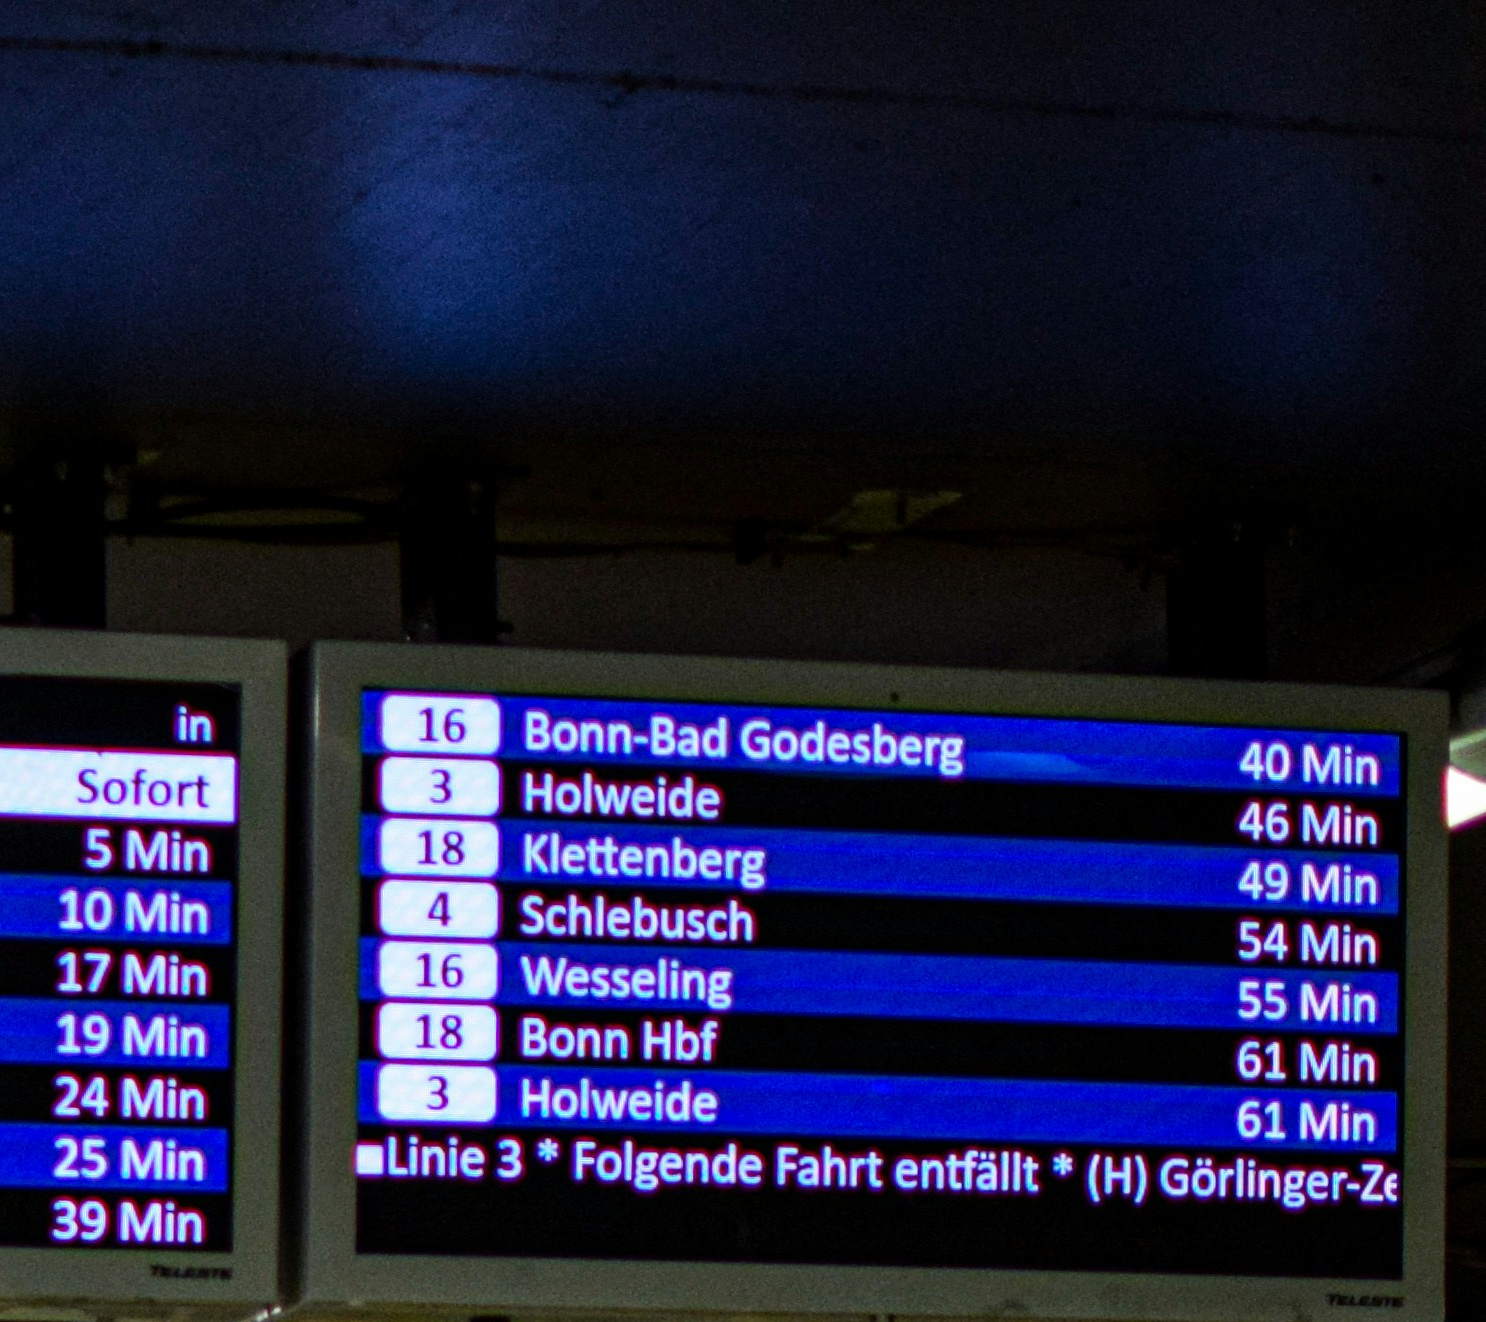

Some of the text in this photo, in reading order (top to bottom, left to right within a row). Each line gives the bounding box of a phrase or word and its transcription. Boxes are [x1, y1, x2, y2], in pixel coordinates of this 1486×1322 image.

[178, 706, 212, 742] in
[420, 707, 1378, 786] 16 Bonn-Bad Godesberg 40 Min
[77, 768, 208, 809] Sofort
[431, 769, 1377, 845] 3 Holweide 46 Min
[86, 828, 112, 869] 5
[126, 830, 208, 872] Min
[419, 830, 1377, 905] 18 Klettenberg 49 Min
[59, 890, 113, 931] 10
[125, 891, 208, 935] Min
[427, 891, 1376, 964] 4 Schlebusch 54 Min
[59, 952, 111, 992] 17
[124, 954, 206, 996] Min
[418, 952, 1376, 1024] 16 Wesseling 55 Min
[57, 1014, 110, 1055] 19
[123, 1015, 206, 1058] Min
[417, 1014, 1375, 1083] 18 Bonn Hbf 61 Min
[55, 1076, 109, 1117] 24
[122, 1078, 204, 1119] Min
[428, 1075, 1375, 1142] 3 Holweide 61 Min
[53, 1137, 107, 1179] 25
[121, 1139, 204, 1182] Min
[388, 1136, 485, 1178] Linie
[497, 1139, 522, 1178] 3
[575, 1140, 762, 1190] Folgende
[777, 1146, 883, 1188] Fahrt
[895, 1150, 1039, 1192] entfällt
[1088, 1154, 1147, 1203] (H)
[53, 1200, 106, 1241] 39
[120, 1201, 202, 1243] Min
